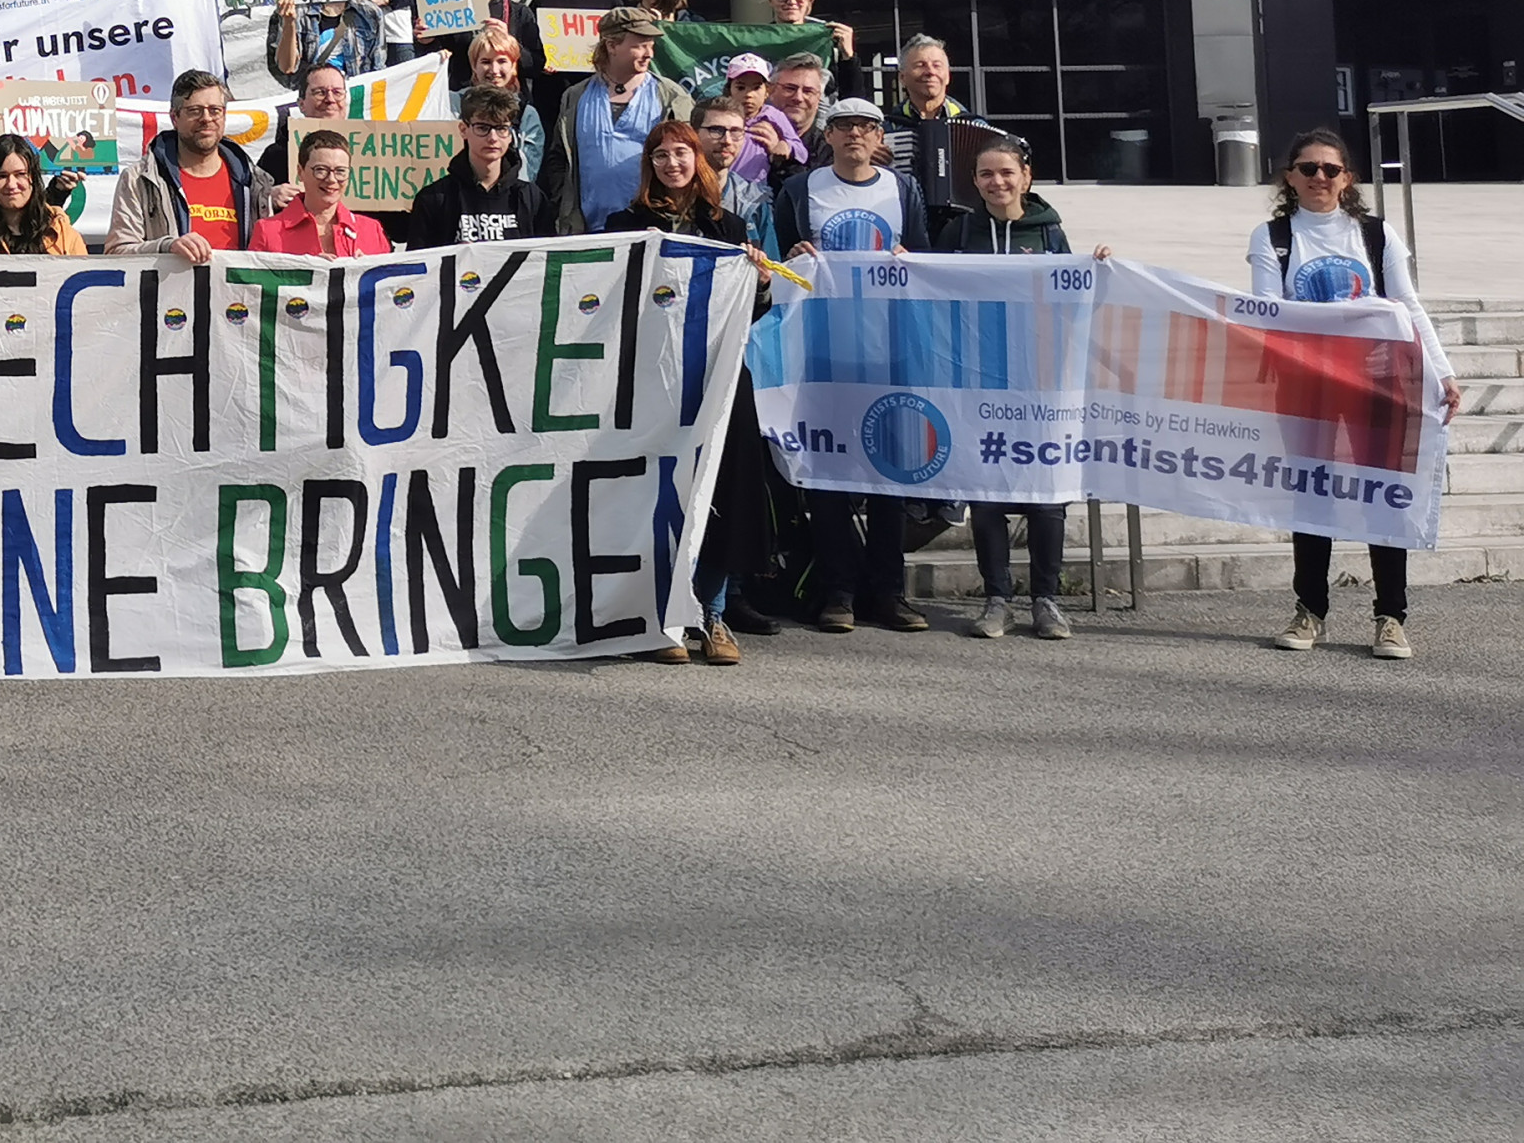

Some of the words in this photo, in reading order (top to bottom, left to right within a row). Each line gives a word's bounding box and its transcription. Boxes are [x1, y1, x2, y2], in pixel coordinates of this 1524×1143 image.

[36, 16, 174, 58] unsere
[424, 7, 476, 29] RÄDER
[546, 14, 560, 38] 3
[866, 265, 909, 287] 1960
[1050, 268, 1093, 291] 1980
[1233, 296, 1279, 318] 2000
[863, 396, 897, 455] SCIENTISTS
[899, 396, 926, 412] FOR
[979, 402, 1026, 421] Global
[1090, 402, 1140, 425] Stripes
[1146, 411, 1164, 432] by
[1169, 413, 1189, 432] Ed
[1195, 417, 1261, 441] Hawkins
[912, 444, 948, 482] FUTURE
[979, 431, 1414, 510] #scientists4future
[216, 445, 702, 670] BRINGEN
